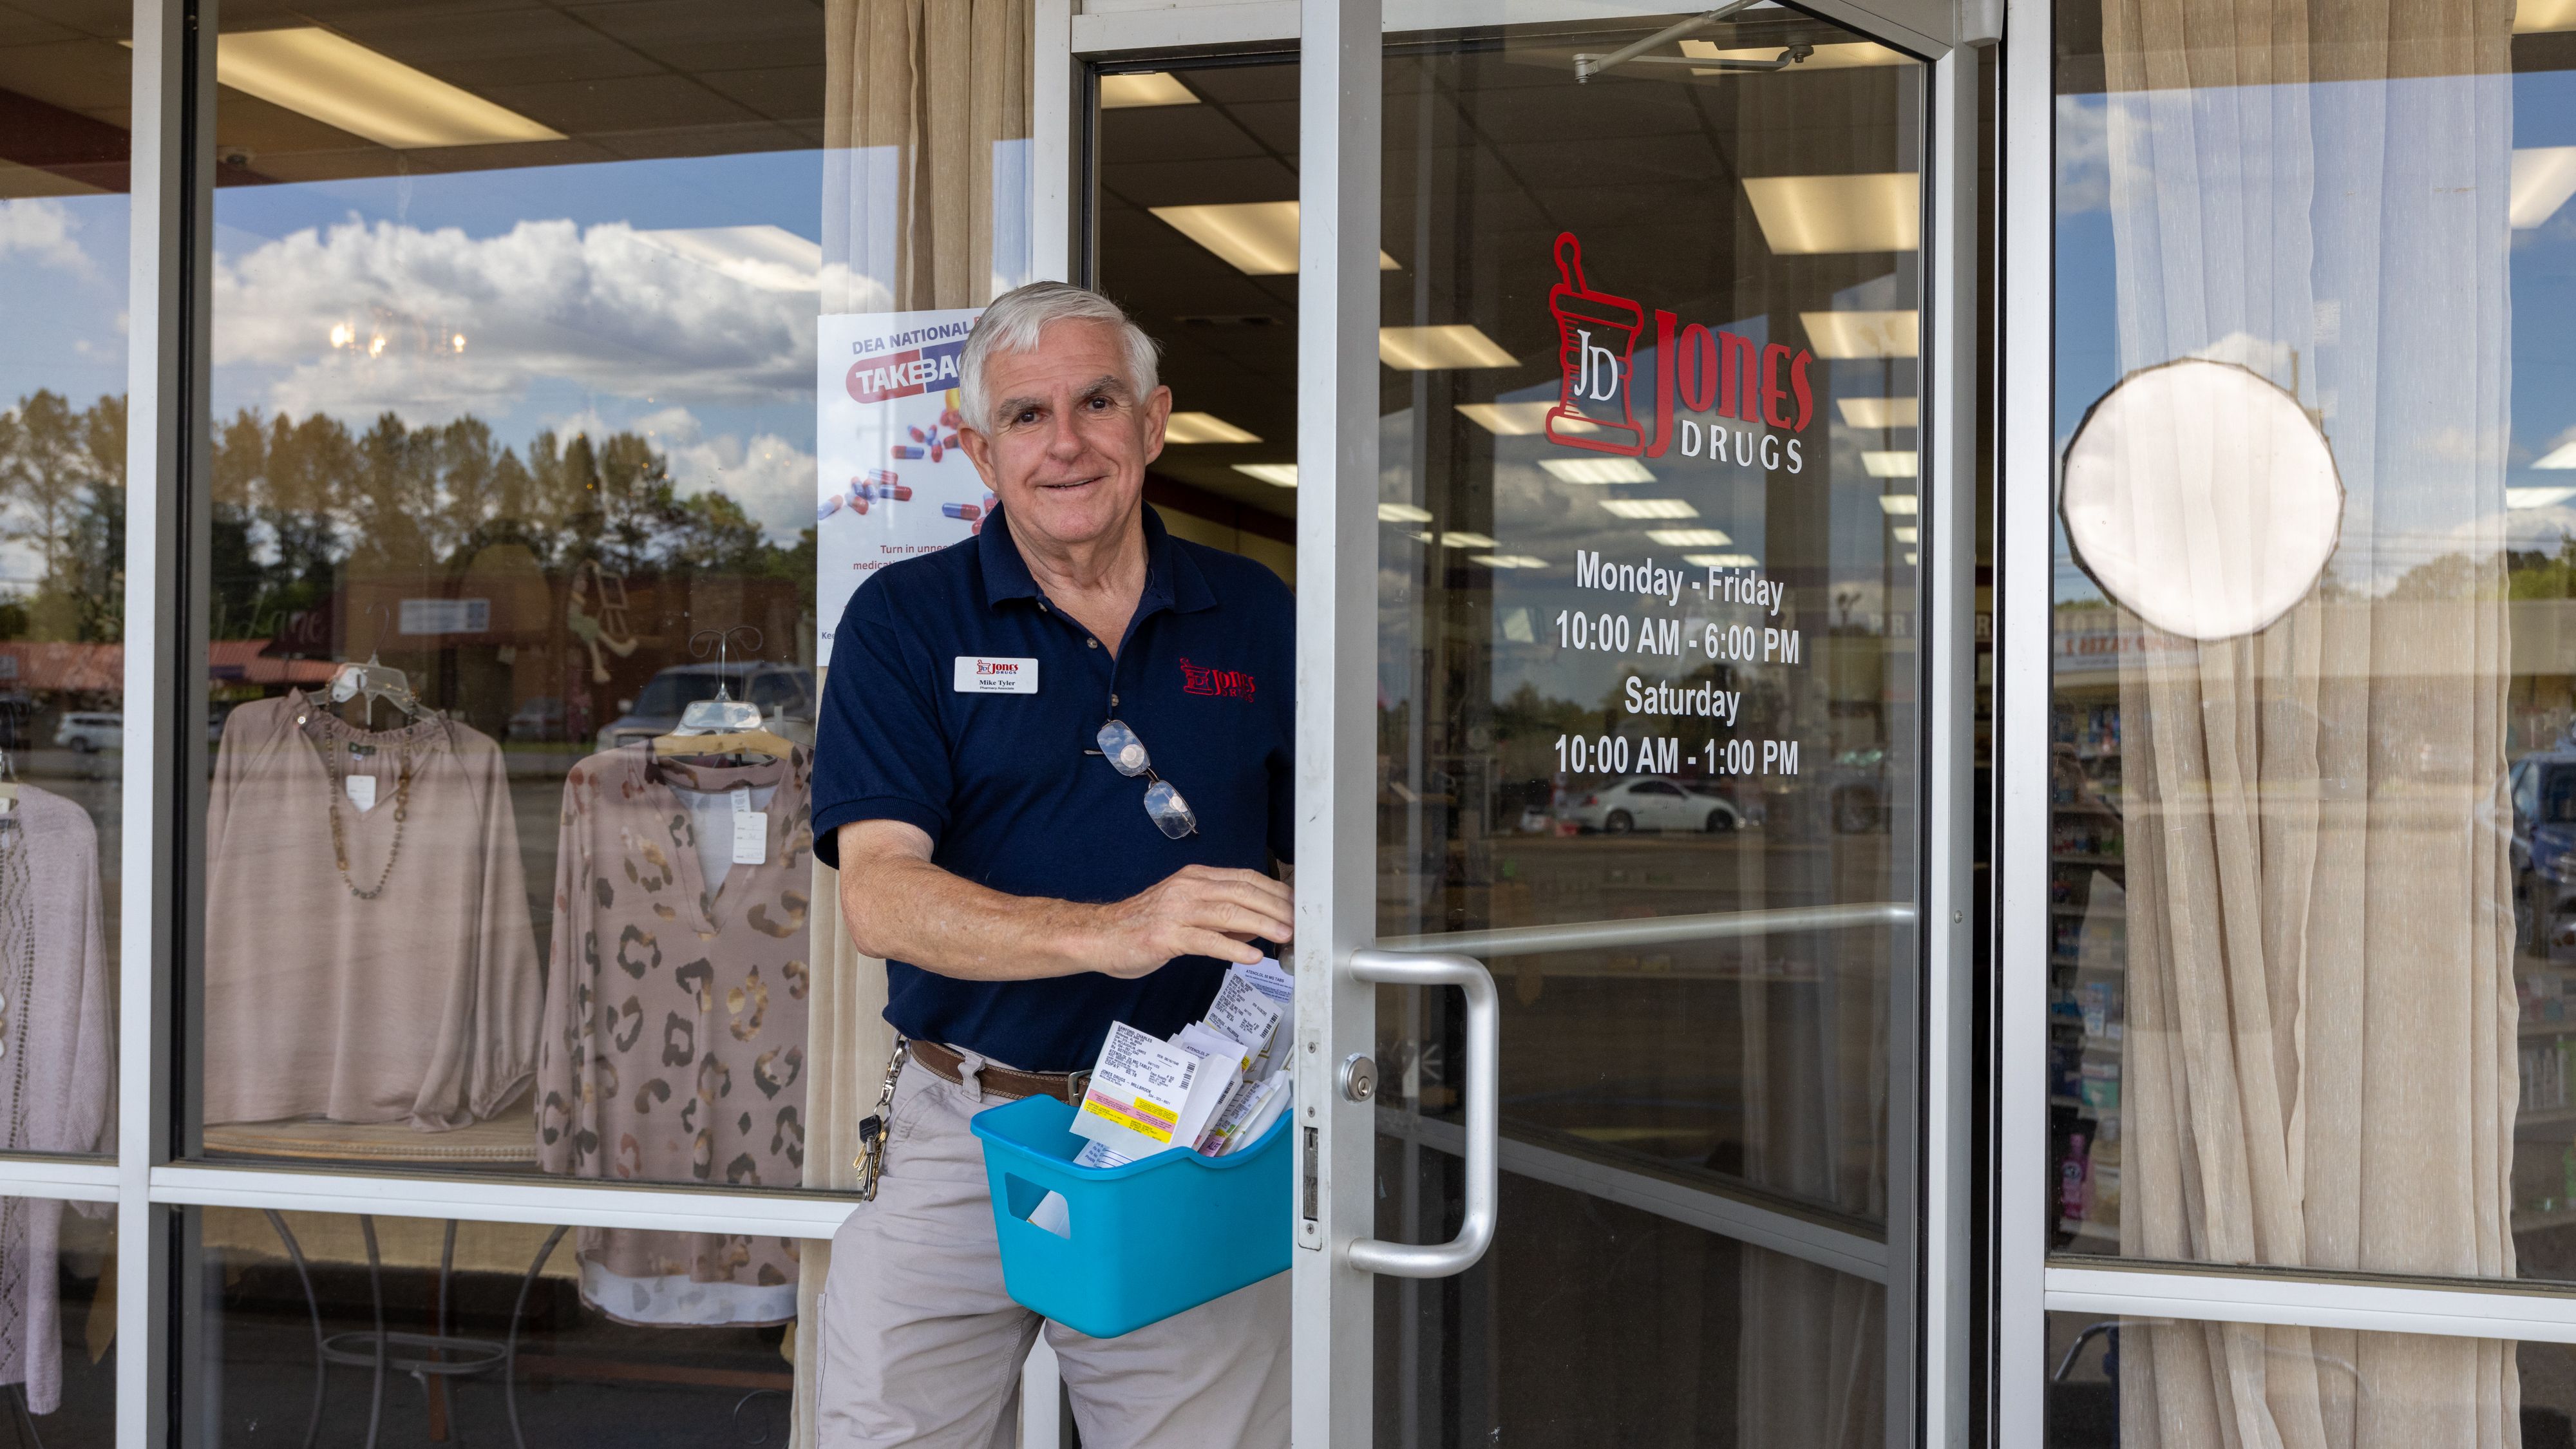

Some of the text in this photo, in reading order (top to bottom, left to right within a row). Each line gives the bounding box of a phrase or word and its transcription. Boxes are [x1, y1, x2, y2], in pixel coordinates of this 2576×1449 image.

[852, 321, 971, 354] DEA NATIONAL
[856, 353, 961, 394] TAKEBA
[1574, 329, 1618, 401] JD
[1680, 419, 1803, 474] DRUGS
[905, 544, 914, 553] in
[1577, 549, 1784, 616] Monday - Friday
[1556, 610, 1629, 653] 10:00
[1636, 618, 1679, 656] AM
[1705, 623, 1756, 661] 6:00
[1764, 627, 1799, 664] PM
[1625, 676, 1740, 727] Saturday
[1555, 734, 1798, 775] 10:00 AM - 1:00 PM
[1135, 1032, 1152, 1043] CHARLES
[1101, 1068, 1113, 1077] JONES
[1112, 1074, 1126, 1083] DRUGS
[1130, 1081, 1151, 1094] MILLBROOK
[1139, 1062, 1152, 1071] TABLET
